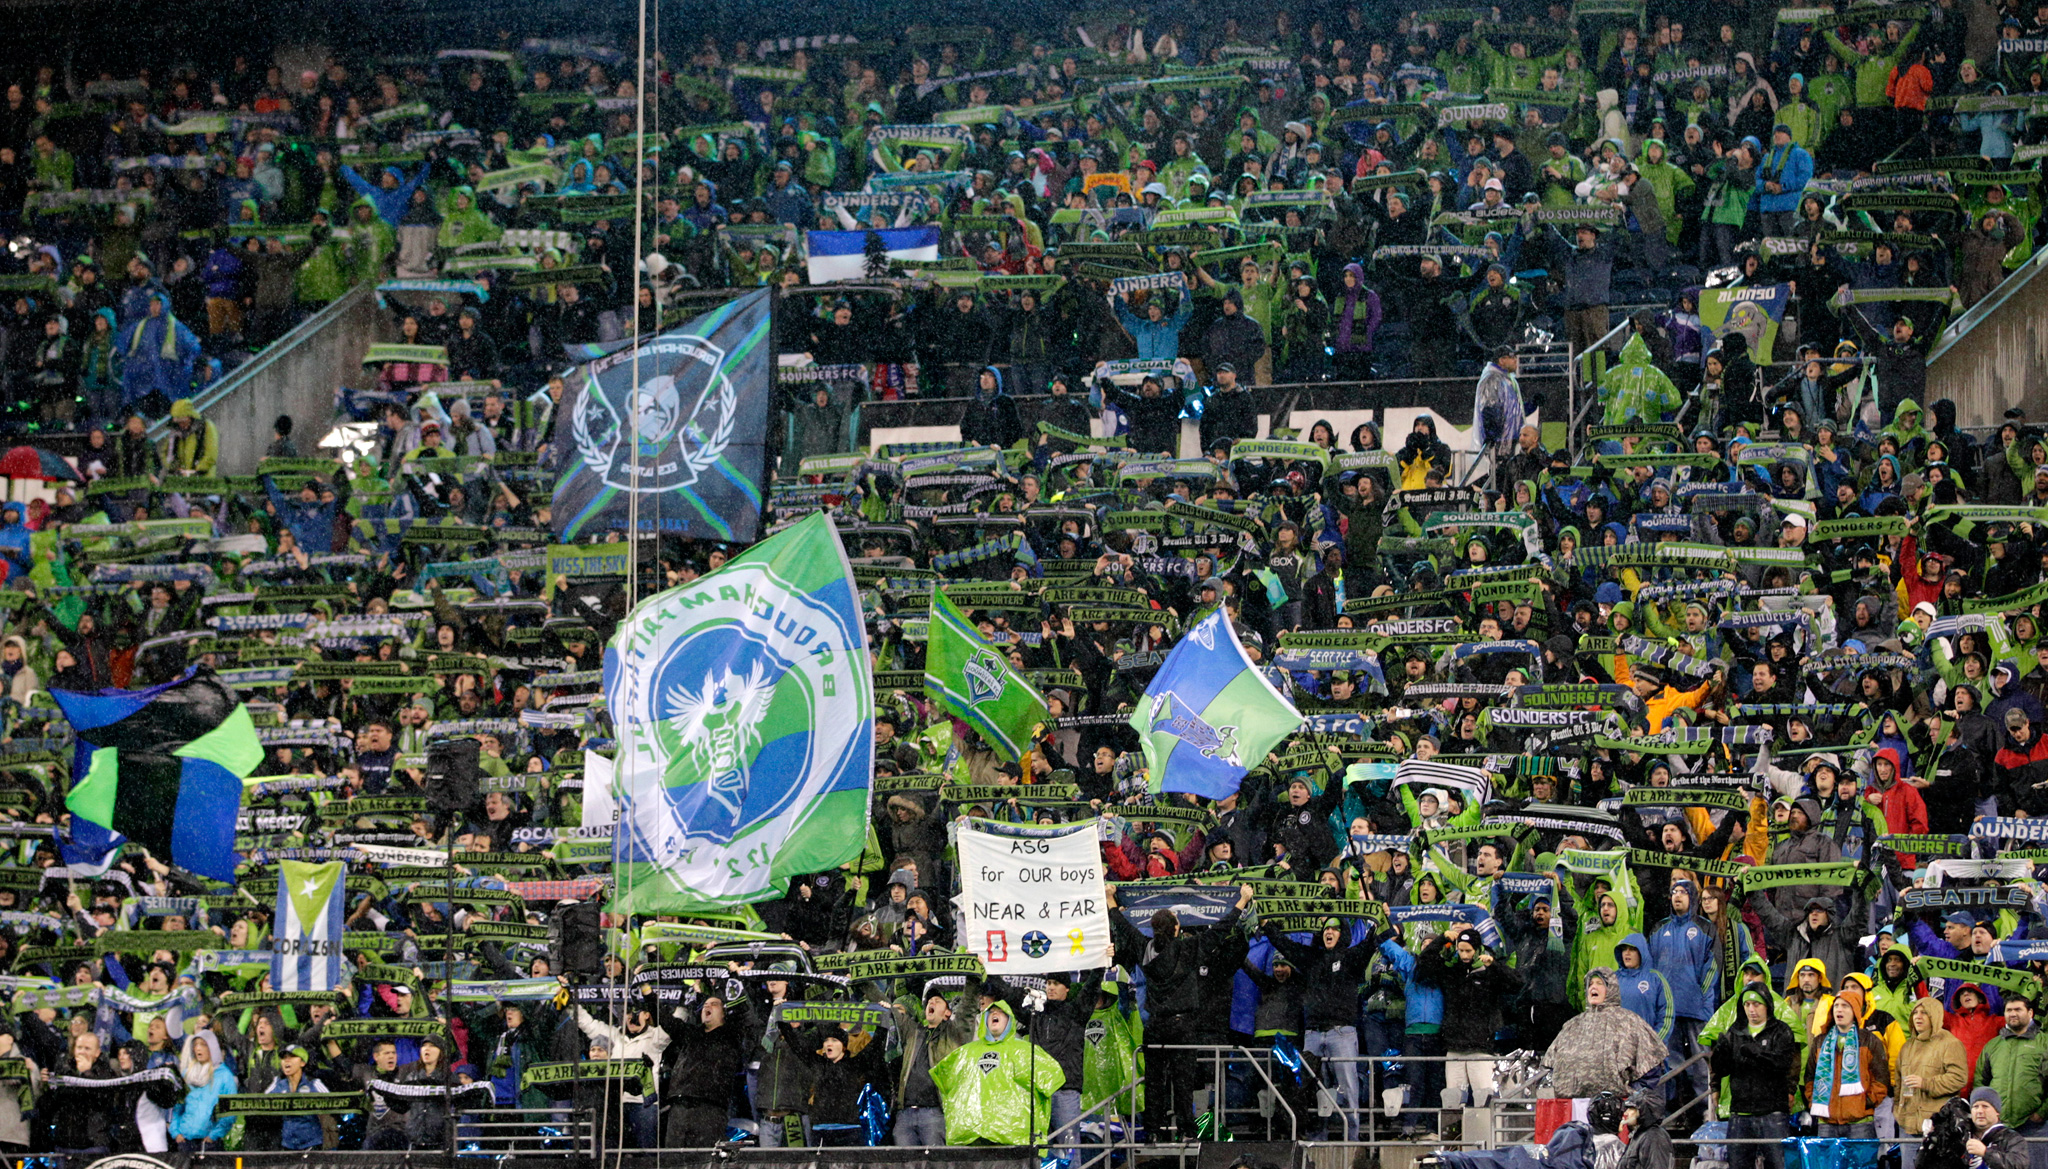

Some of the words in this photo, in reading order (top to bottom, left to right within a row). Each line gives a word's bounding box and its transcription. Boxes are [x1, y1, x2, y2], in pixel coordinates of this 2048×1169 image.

[1671, 66, 1727, 79] SOUNDERS
[1438, 104, 1509, 127] SOUNDERS
[869, 127, 949, 145] SOUNDERS
[1958, 171, 2019, 182] SOUNDERS
[2024, 172, 2040, 182] FC
[825, 193, 898, 208] OUNDERS
[903, 193, 923, 208] FC
[1557, 208, 1616, 220] SOUNDERS
[1825, 229, 1861, 242] EMERALD
[1863, 232, 1882, 243] CITY
[1108, 275, 1184, 296] OUNDERS
[1717, 287, 1776, 303] ALONSO
[1110, 362, 1129, 372] NO
[1131, 360, 1173, 372] EQUAL
[779, 367, 838, 382] SOUNDERS
[841, 368, 856, 379] FC
[1232, 443, 1299, 455] SOUNDERS
[1301, 446, 1320, 458] FC
[1339, 454, 1379, 468] SOUNDERS
[1380, 453, 1394, 466] FC
[1404, 492, 1432, 503] Seattle
[1434, 490, 1446, 501] Til
[1457, 490, 1471, 501] Die
[1102, 513, 1164, 527] SOUNDERS
[1442, 513, 1497, 522] SOUNDERS
[1501, 513, 1518, 523] FC
[1815, 520, 1886, 536] SOUNDERS
[1889, 519, 1906, 531] FC
[1162, 536, 1193, 546] Seattle
[1218, 534, 1234, 545] Die
[1614, 553, 1633, 564] WE
[1636, 553, 1658, 564] ARE
[1689, 556, 1710, 568] THE
[1756, 549, 1805, 562] SOUNDERS
[552, 557, 580, 574] KISS
[583, 556, 604, 573] THE
[605, 554, 628, 572] SKY
[1052, 589, 1075, 602] ARE
[1106, 590, 1127, 602] THE
[1531, 610, 1548, 619] 2012
[1731, 610, 1791, 626] Sounders
[1371, 619, 1432, 636] OUNDERS
[1434, 618, 1453, 633] FC
[1285, 636, 1357, 647] SOUNDERS
[1365, 636, 1381, 648] FC
[1472, 638, 1514, 652] SOUNDERS
[1515, 640, 1526, 651] FC
[1586, 637, 1609, 651] ARE
[1309, 650, 1354, 664] SEATTLE
[894, 674, 911, 688] CITY
[1059, 673, 1079, 686] THE
[1543, 683, 1599, 692] SEATTLE
[1523, 690, 1596, 707] SOUNDERS
[1599, 691, 1616, 705] FC
[1491, 708, 1567, 725] SOUNDERS
[1569, 710, 1589, 724] FC
[1332, 717, 1359, 733] FC
[1688, 737, 1708, 748] FC
[488, 776, 527, 790] FUN
[1699, 776, 1709, 785] the
[1710, 775, 1751, 786] Northwest
[943, 788, 964, 800] WE
[966, 786, 989, 799] ARE
[1023, 785, 1047, 798] THE
[1049, 784, 1068, 798] ECS
[1628, 789, 1651, 803] WE
[1653, 789, 1672, 802] ARE
[1704, 792, 1724, 804] THE
[1725, 794, 1745, 809] ECS
[369, 800, 390, 811] ARE
[1137, 804, 1156, 817] CITY
[1157, 806, 1207, 822] SUPPORTERS
[255, 815, 307, 831] MERCY
[512, 825, 560, 840] SOCAL
[1010, 839, 1050, 855] ASG
[1946, 841, 1963, 856] FC
[369, 849, 431, 866] OUNDERS
[453, 851, 481, 864] ERALD
[483, 852, 500, 864] CITY
[980, 865, 1005, 883] for
[1018, 866, 1053, 884] OUR
[1059, 865, 1096, 885] boys
[1744, 867, 1822, 885] SOUNDERS
[1828, 867, 1847, 880] FC
[412, 887, 448, 899] EMERAL
[453, 888, 471, 900] CITY
[1299, 885, 1320, 897] THE
[1904, 887, 2030, 909] SEATTLE
[145, 896, 200, 910] SEATTLE
[973, 902, 1026, 921] NEAR
[1038, 902, 1051, 919] &
[1059, 899, 1097, 919] FAR
[1255, 901, 1275, 914] WE
[1277, 900, 1301, 913] ARE
[1335, 901, 1360, 914] THE
[1362, 901, 1382, 916] ECS
[1396, 907, 1448, 922] SOUNDERS
[1451, 908, 1467, 921] FC
[471, 924, 510, 936] EMERALD
[511, 925, 528, 937] CITY
[1725, 927, 1737, 977] EMERALD
[823, 955, 843, 968] ARE
[868, 962, 892, 976] ARE
[929, 958, 954, 971] THE
[956, 956, 977, 971] ECS
[631, 970, 659, 983] GROU
[660, 968, 704, 980] SERVICES
[1926, 958, 2012, 983] SOUNDERS
[2016, 974, 2036, 993] FC
[263, 991, 282, 1001] CITY
[283, 990, 338, 1001] SUPPORTERS
[805, 1001, 867, 1009] SEATTLE
[781, 1007, 860, 1024] SOUNDERS
[862, 1009, 883, 1024] FC
[337, 1023, 365, 1035] ARE
[402, 1022, 424, 1034] THE
[531, 1067, 552, 1081] WE
[554, 1066, 575, 1079] ARE
[230, 1099, 269, 1110] EMERALD
[270, 1099, 289, 1110] CITY
[291, 1097, 349, 1110] SUPPORTERS
